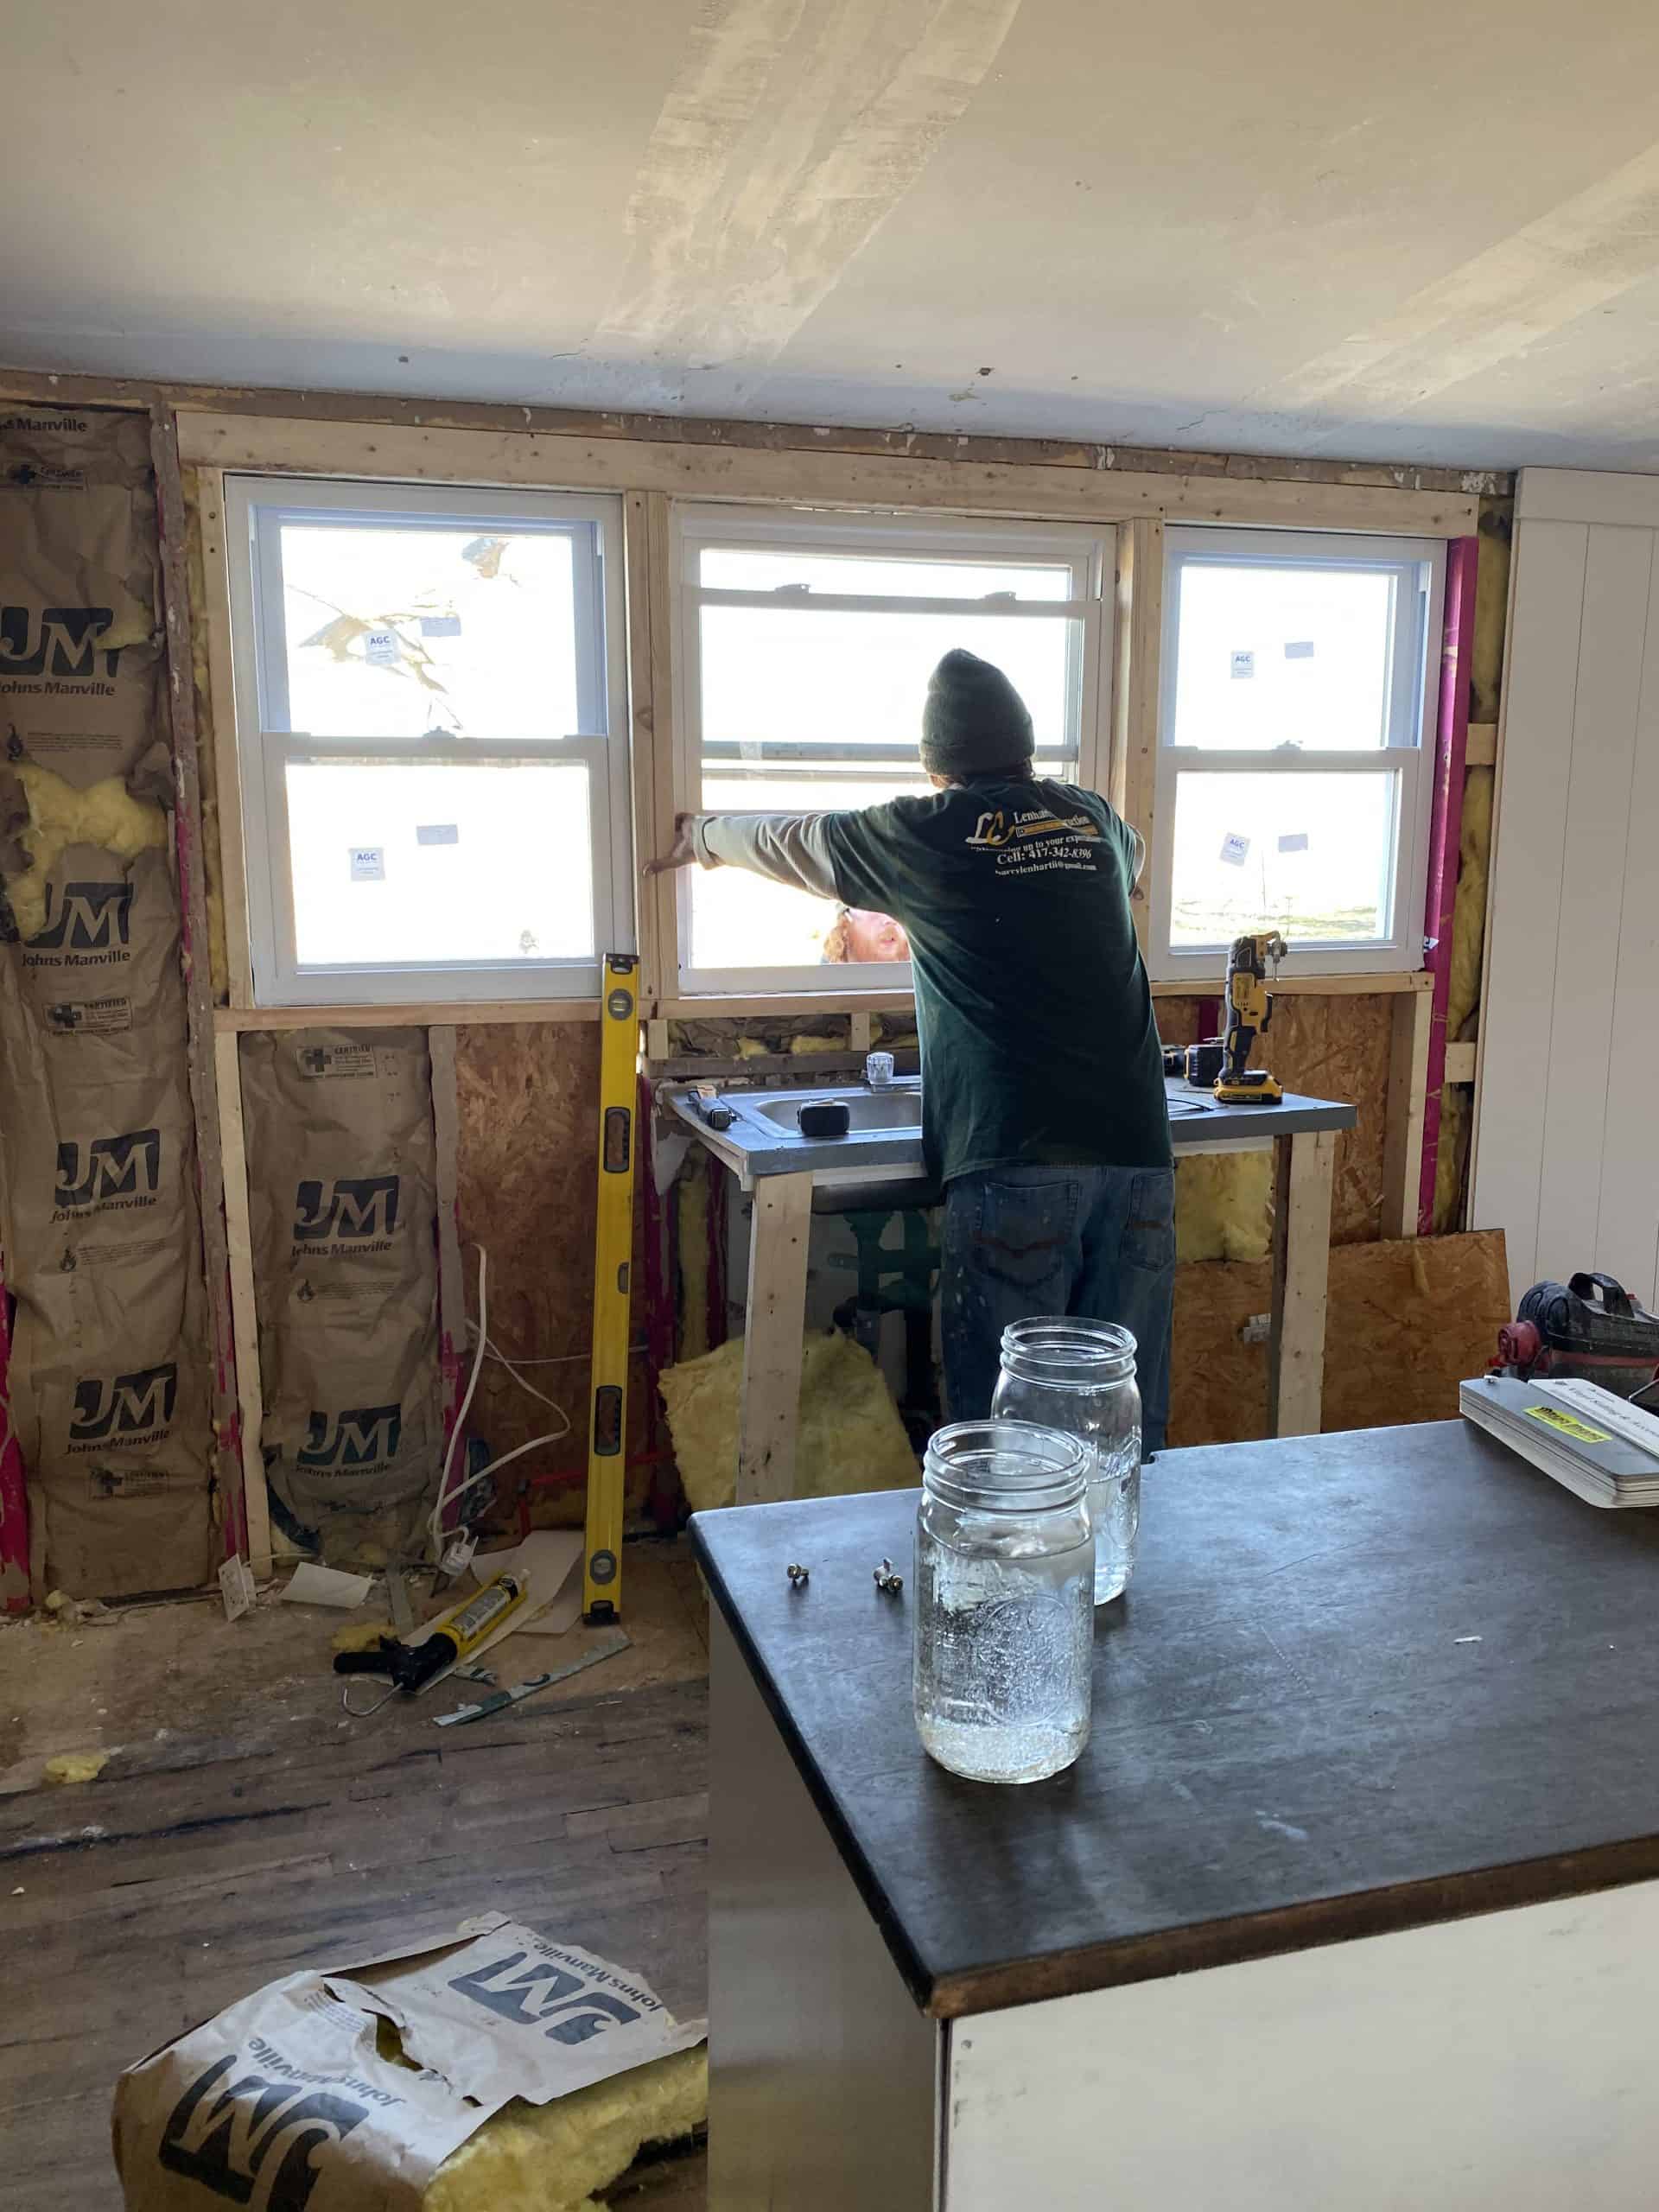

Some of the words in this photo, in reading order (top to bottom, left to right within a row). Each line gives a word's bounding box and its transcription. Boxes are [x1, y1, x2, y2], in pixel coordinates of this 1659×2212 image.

[370, 635, 391, 645] AGC
[1235, 655, 1251, 664] AGC
[45, 682, 116, 696] Manville
[356, 852, 377, 861] AGC
[997, 850, 1026, 865] Cell:
[1028, 847, 1092, 860] 417-342-8396
[24, 882, 135, 949] JM
[22, 952, 62, 966] Johns
[64, 950, 130, 966] Manville
[54, 1128, 160, 1206] JM
[293, 1175, 400, 1241] JM
[331, 1240, 393, 1255] Manville
[69, 1362, 178, 1440] JM
[296, 1403, 402, 1466] JM
[532, 1941, 611, 1984] Manville
[448, 1951, 642, 2045] JM
[607, 1974, 664, 2012] Johns
[157, 2054, 369, 2212] JM
